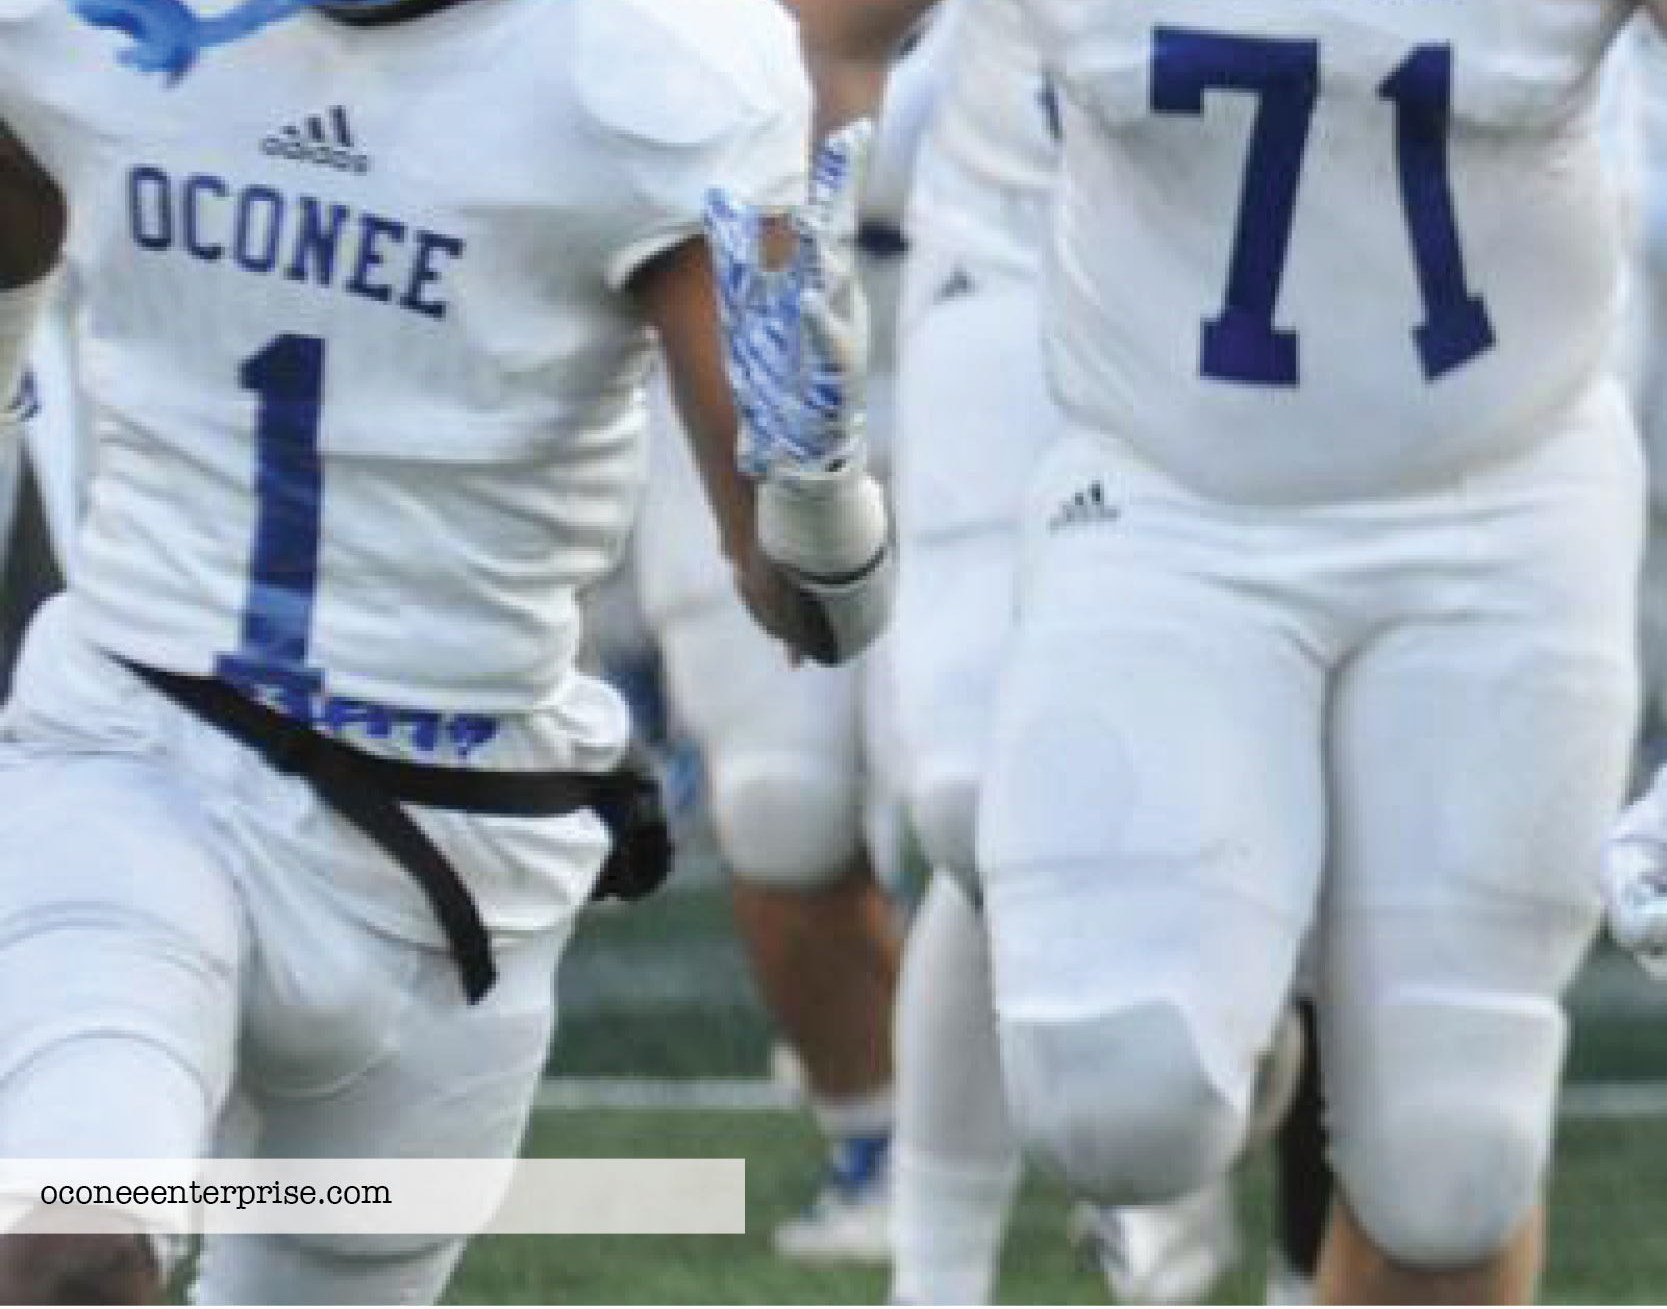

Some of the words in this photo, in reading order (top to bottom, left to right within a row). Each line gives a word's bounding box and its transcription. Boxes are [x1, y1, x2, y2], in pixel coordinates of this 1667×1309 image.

[126, 167, 467, 319] OCONEE
[1150, 24, 1496, 389] 71
[214, 333, 327, 687] 1
